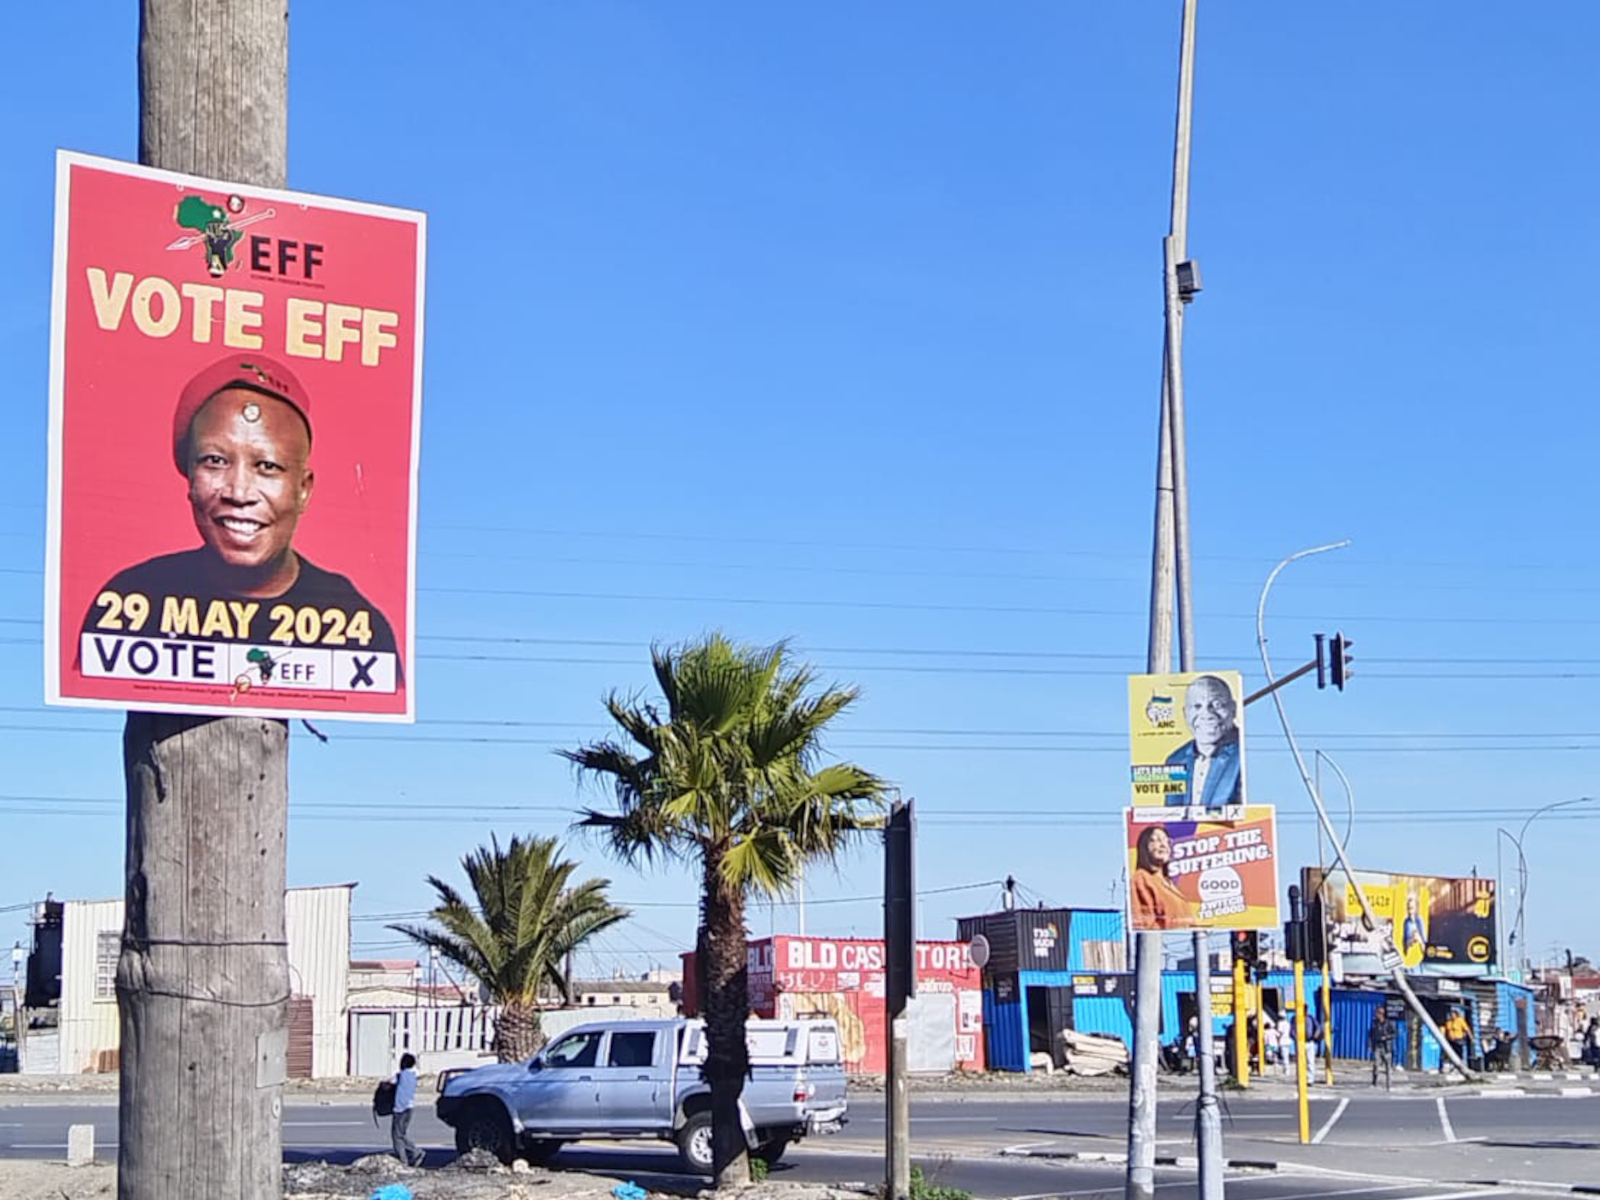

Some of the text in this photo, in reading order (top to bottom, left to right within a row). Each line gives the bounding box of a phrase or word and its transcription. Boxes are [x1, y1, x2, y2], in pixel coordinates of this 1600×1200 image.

[250, 235, 324, 280] EFF
[86, 267, 398, 366] VOTE EFF
[96, 590, 372, 646] 29 MAY 2024
[94, 636, 215, 679] VOTE
[280, 663, 316, 682] EFF
[1157, 720, 1175, 729] ANC
[1134, 782, 1184, 794] VOTE ANC
[1174, 830, 1261, 858] STOP THE
[1168, 845, 1272, 876] SUFFERING.
[1200, 880, 1239, 890] GOOD
[788, 941, 837, 970] BLD
[841, 944, 886, 970] CAS
